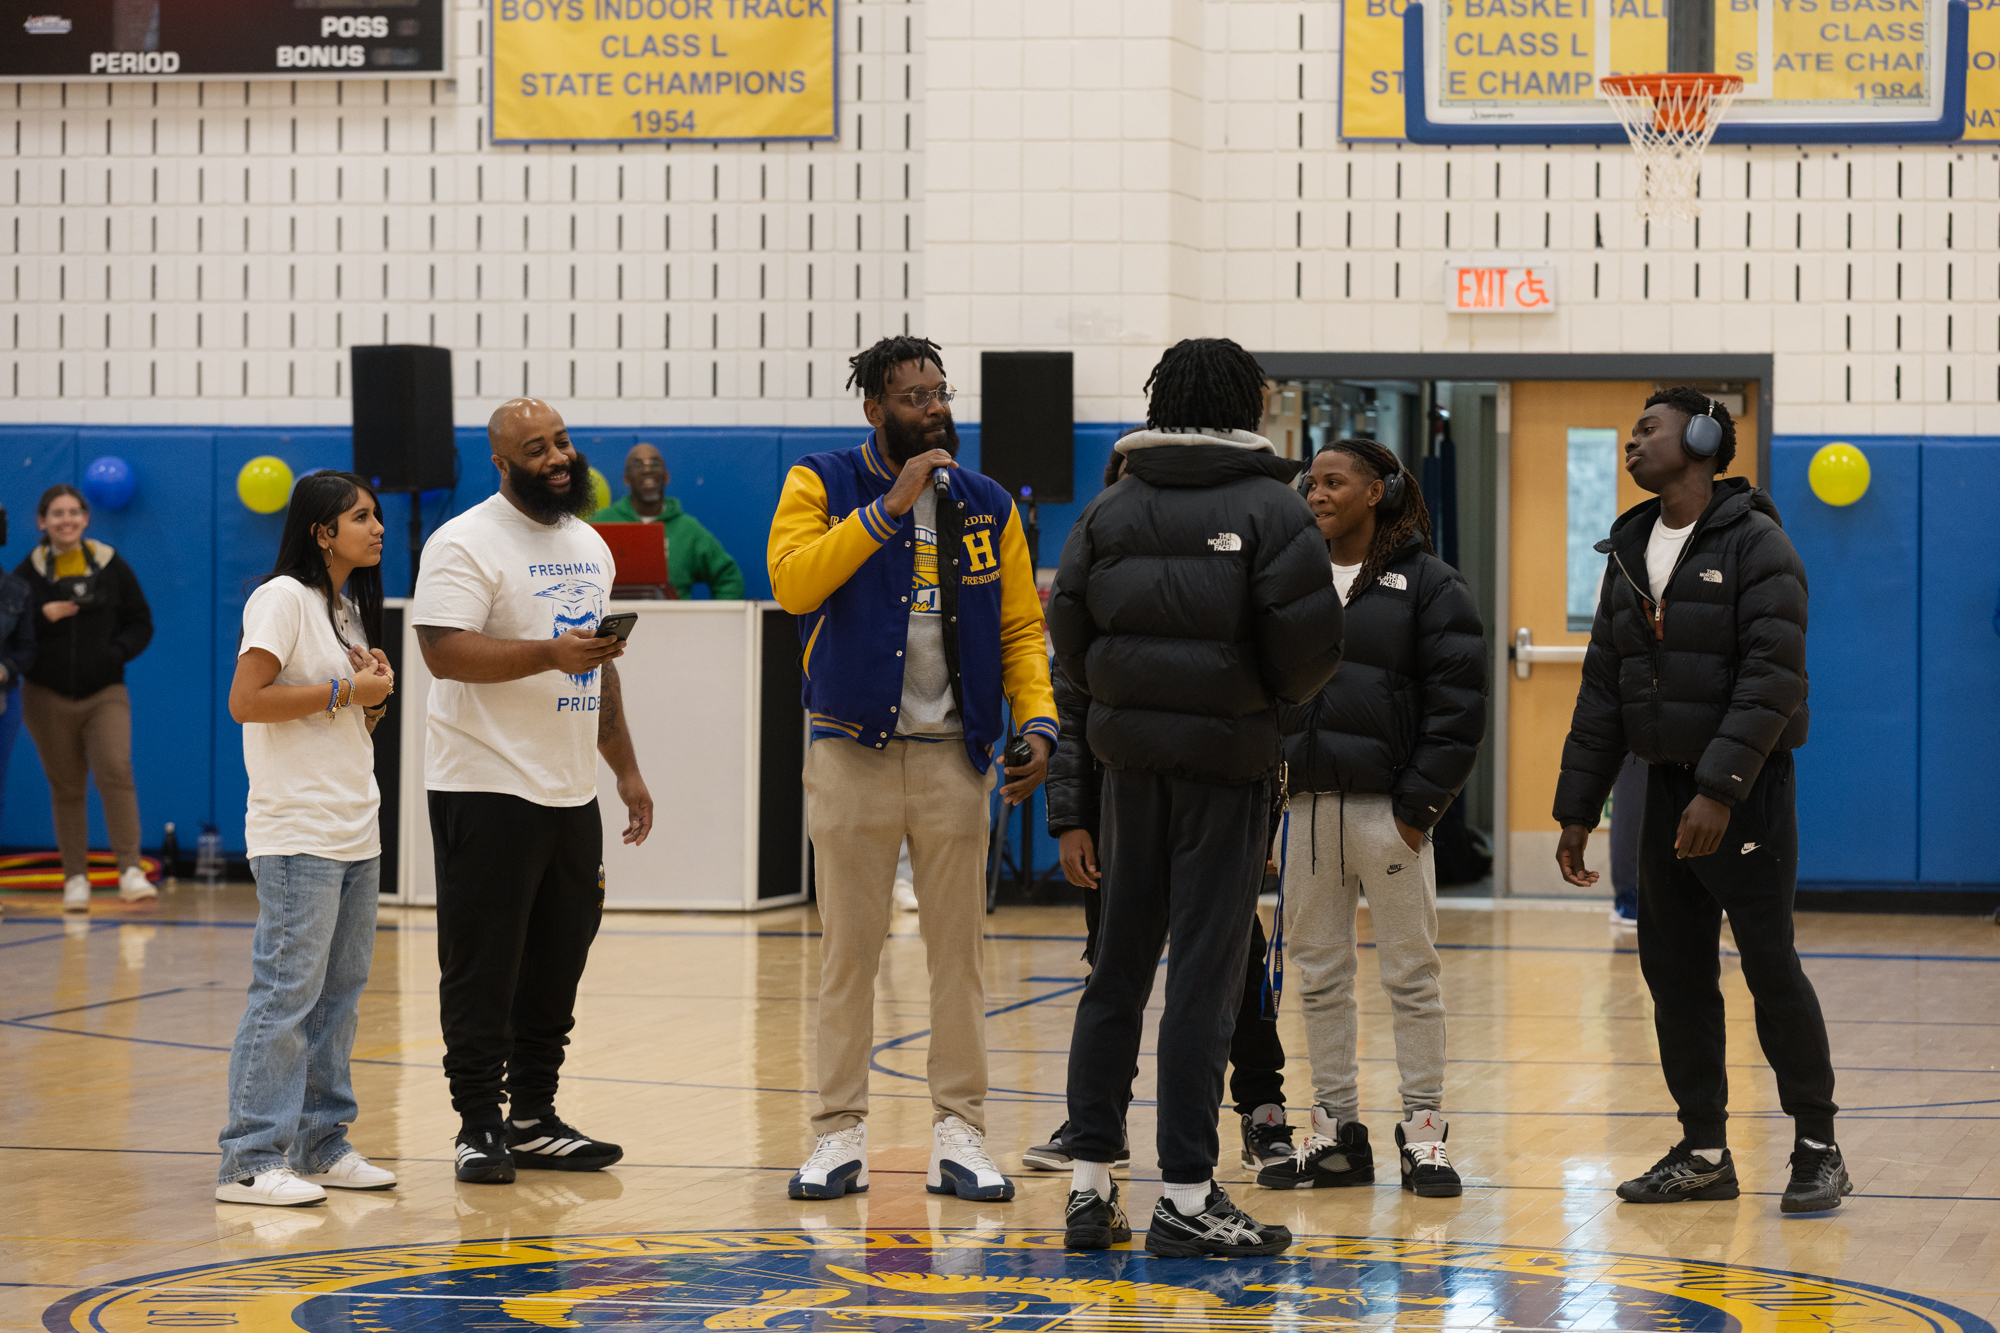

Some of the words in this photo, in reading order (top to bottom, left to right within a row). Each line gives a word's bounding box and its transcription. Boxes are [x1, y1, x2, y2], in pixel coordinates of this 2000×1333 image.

[501, 0, 584, 21] BOYS
[595, 0, 713, 21] INDOOR
[724, 0, 828, 19] TRACK
[321, 16, 389, 38] POSS
[1819, 22, 1924, 41] CLASS
[601, 34, 701, 58] CLASS
[712, 34, 728, 57] L
[1455, 33, 1559, 56] CLASS
[1571, 33, 1588, 56] L
[90, 52, 180, 73] PERIOD
[276, 45, 366, 67] BONUS
[1735, 51, 1834, 72] SATE
[520, 73, 613, 96] STATE
[623, 70, 806, 95] CHAMPIONS
[1370, 70, 1467, 94] STE
[1478, 71, 1593, 95] CHAMP
[1854, 82, 1924, 99] 1984
[631, 109, 697, 133] 1954
[1457, 268, 1508, 308] EXIT
[962, 529, 997, 572] H
[529, 562, 601, 577] FRESHMAN
[961, 568, 1001, 585] PRESIDEN
[137, 1249, 522, 1303] WARREN
[1495, 1256, 1869, 1312] SCHOOL
[146, 1310, 240, 1327] OF
